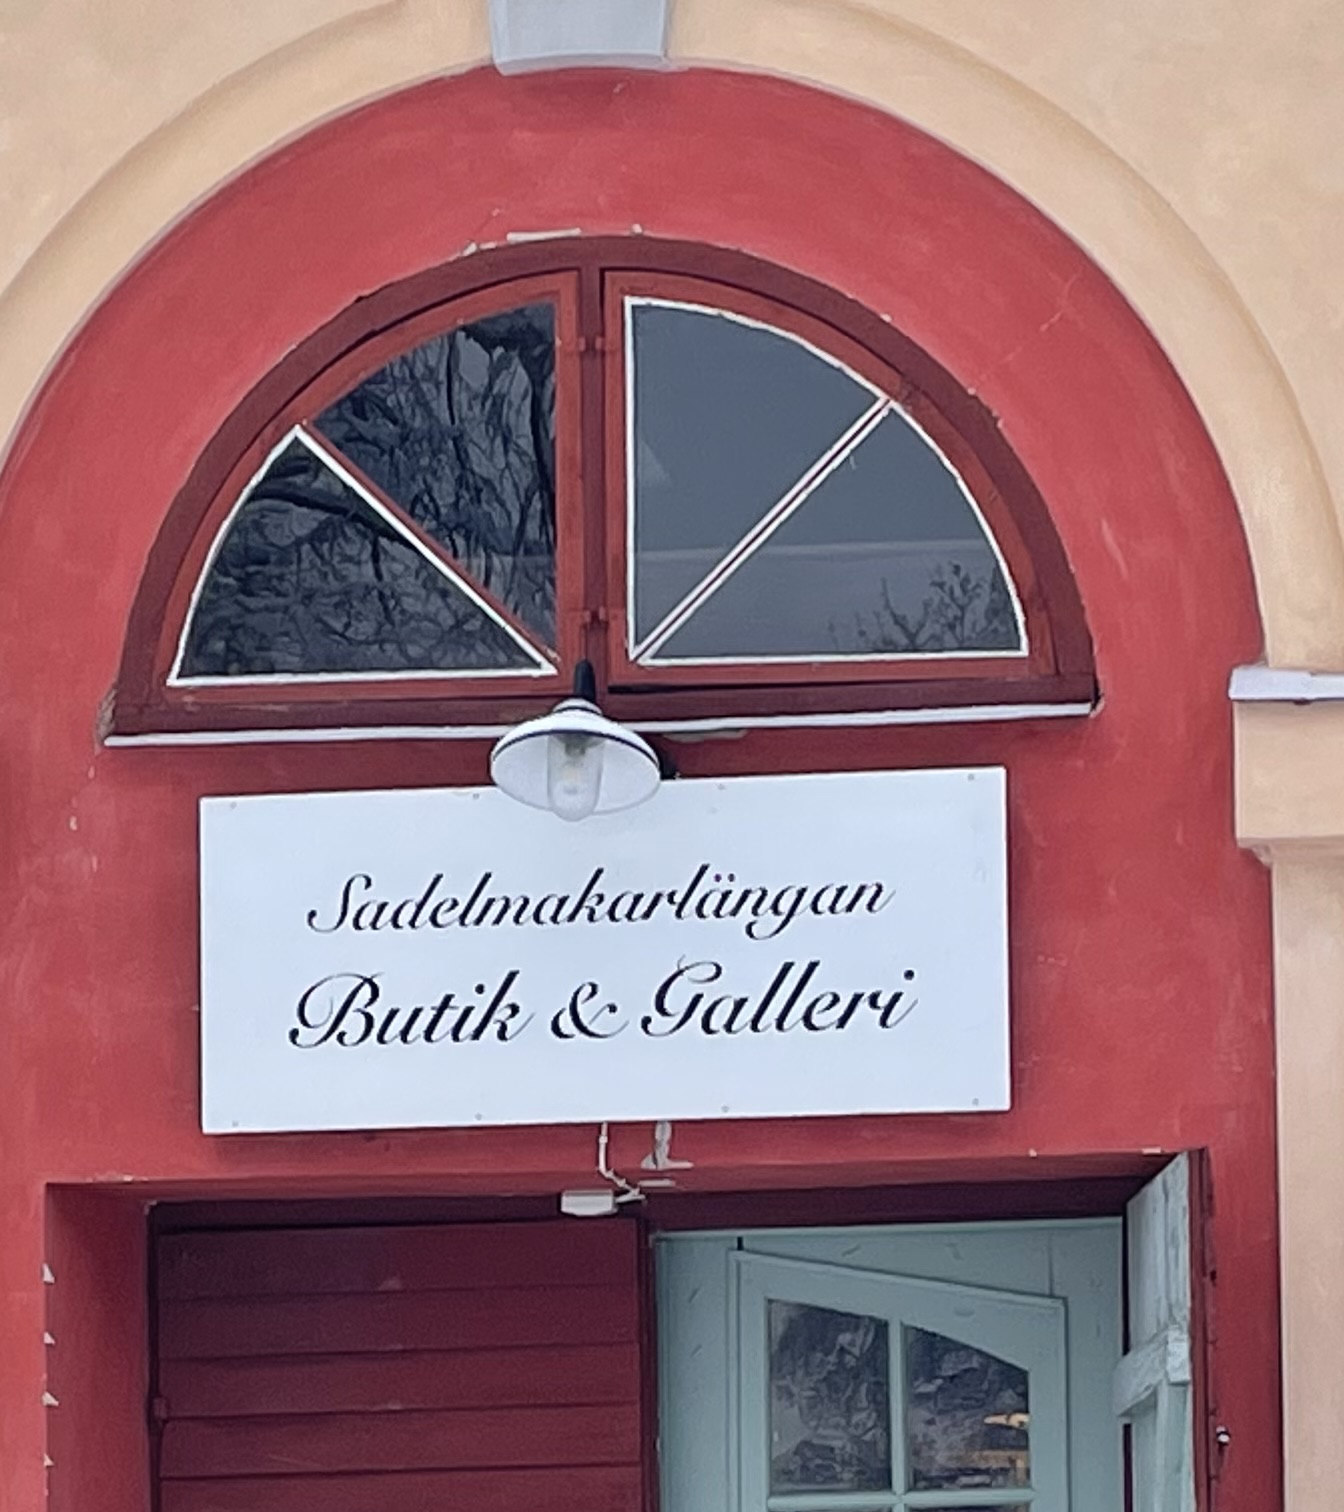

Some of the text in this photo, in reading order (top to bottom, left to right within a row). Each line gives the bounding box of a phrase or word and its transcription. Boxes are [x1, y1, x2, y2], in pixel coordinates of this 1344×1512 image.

[306, 863, 896, 941] Sadelmakarlängan
[289, 954, 920, 1048] Butik & Galleri
